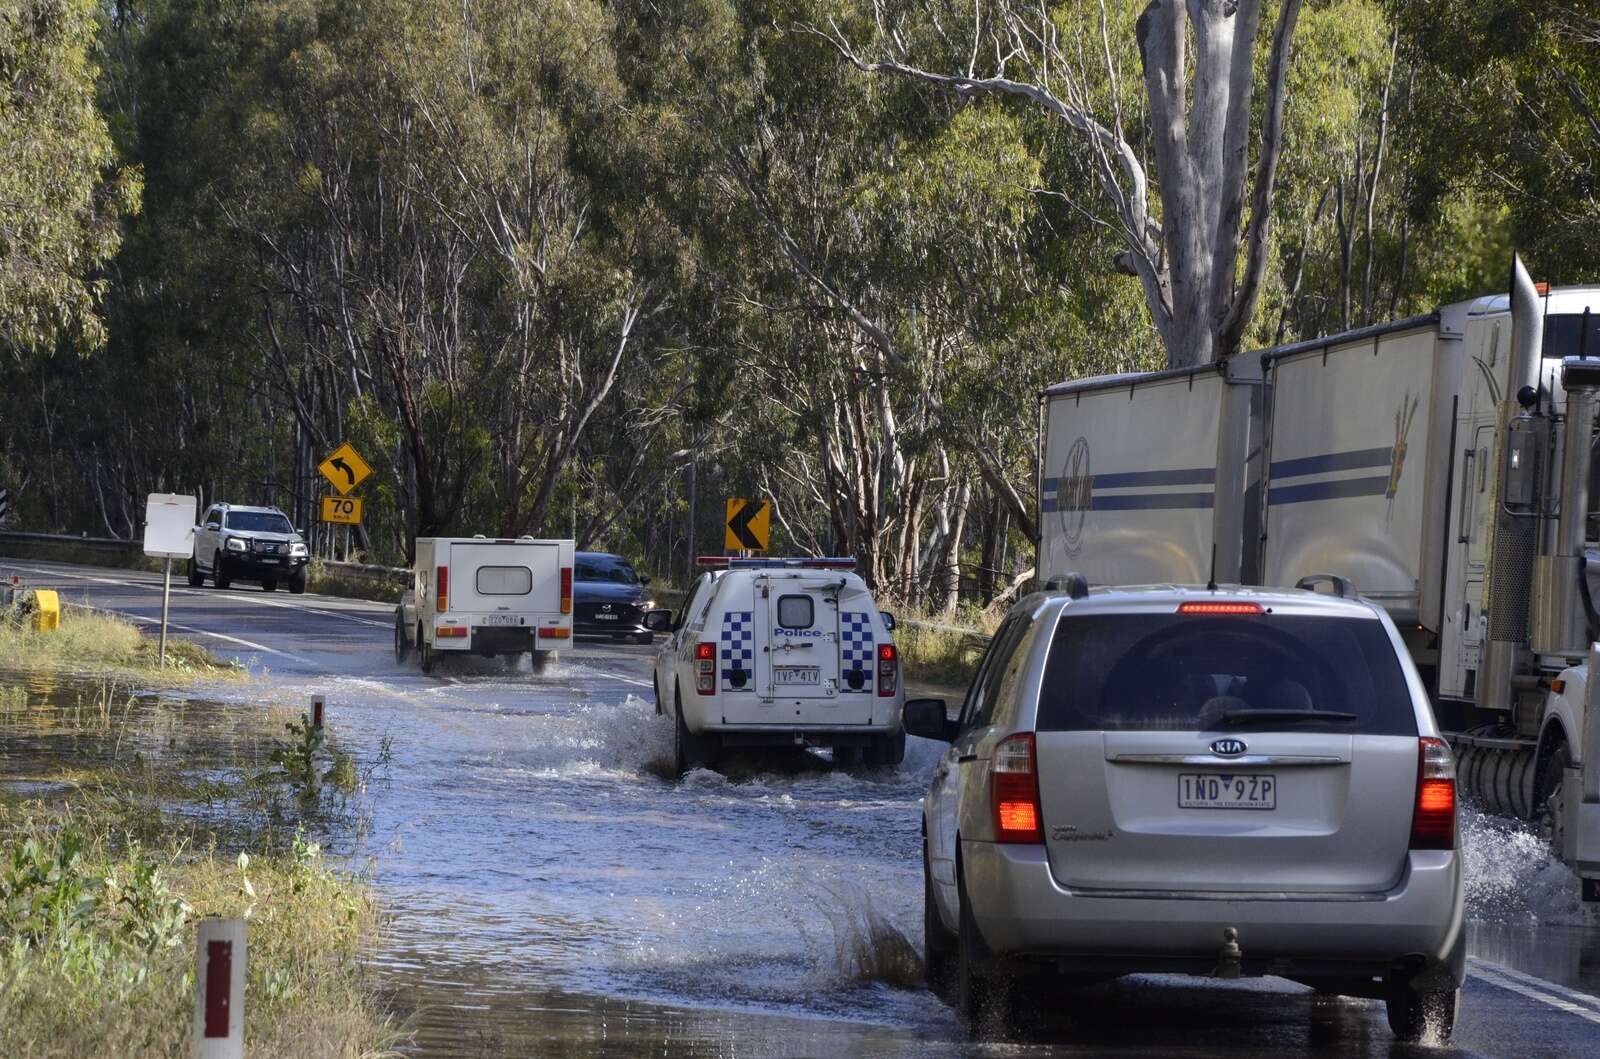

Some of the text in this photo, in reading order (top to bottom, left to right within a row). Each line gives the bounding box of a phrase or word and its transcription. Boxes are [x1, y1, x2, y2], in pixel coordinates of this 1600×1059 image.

[331, 500, 354, 514] 70
[774, 628, 822, 637] Police
[1216, 741, 1242, 752] KIA
[1185, 779, 1272, 801] 1ND 9ZP
